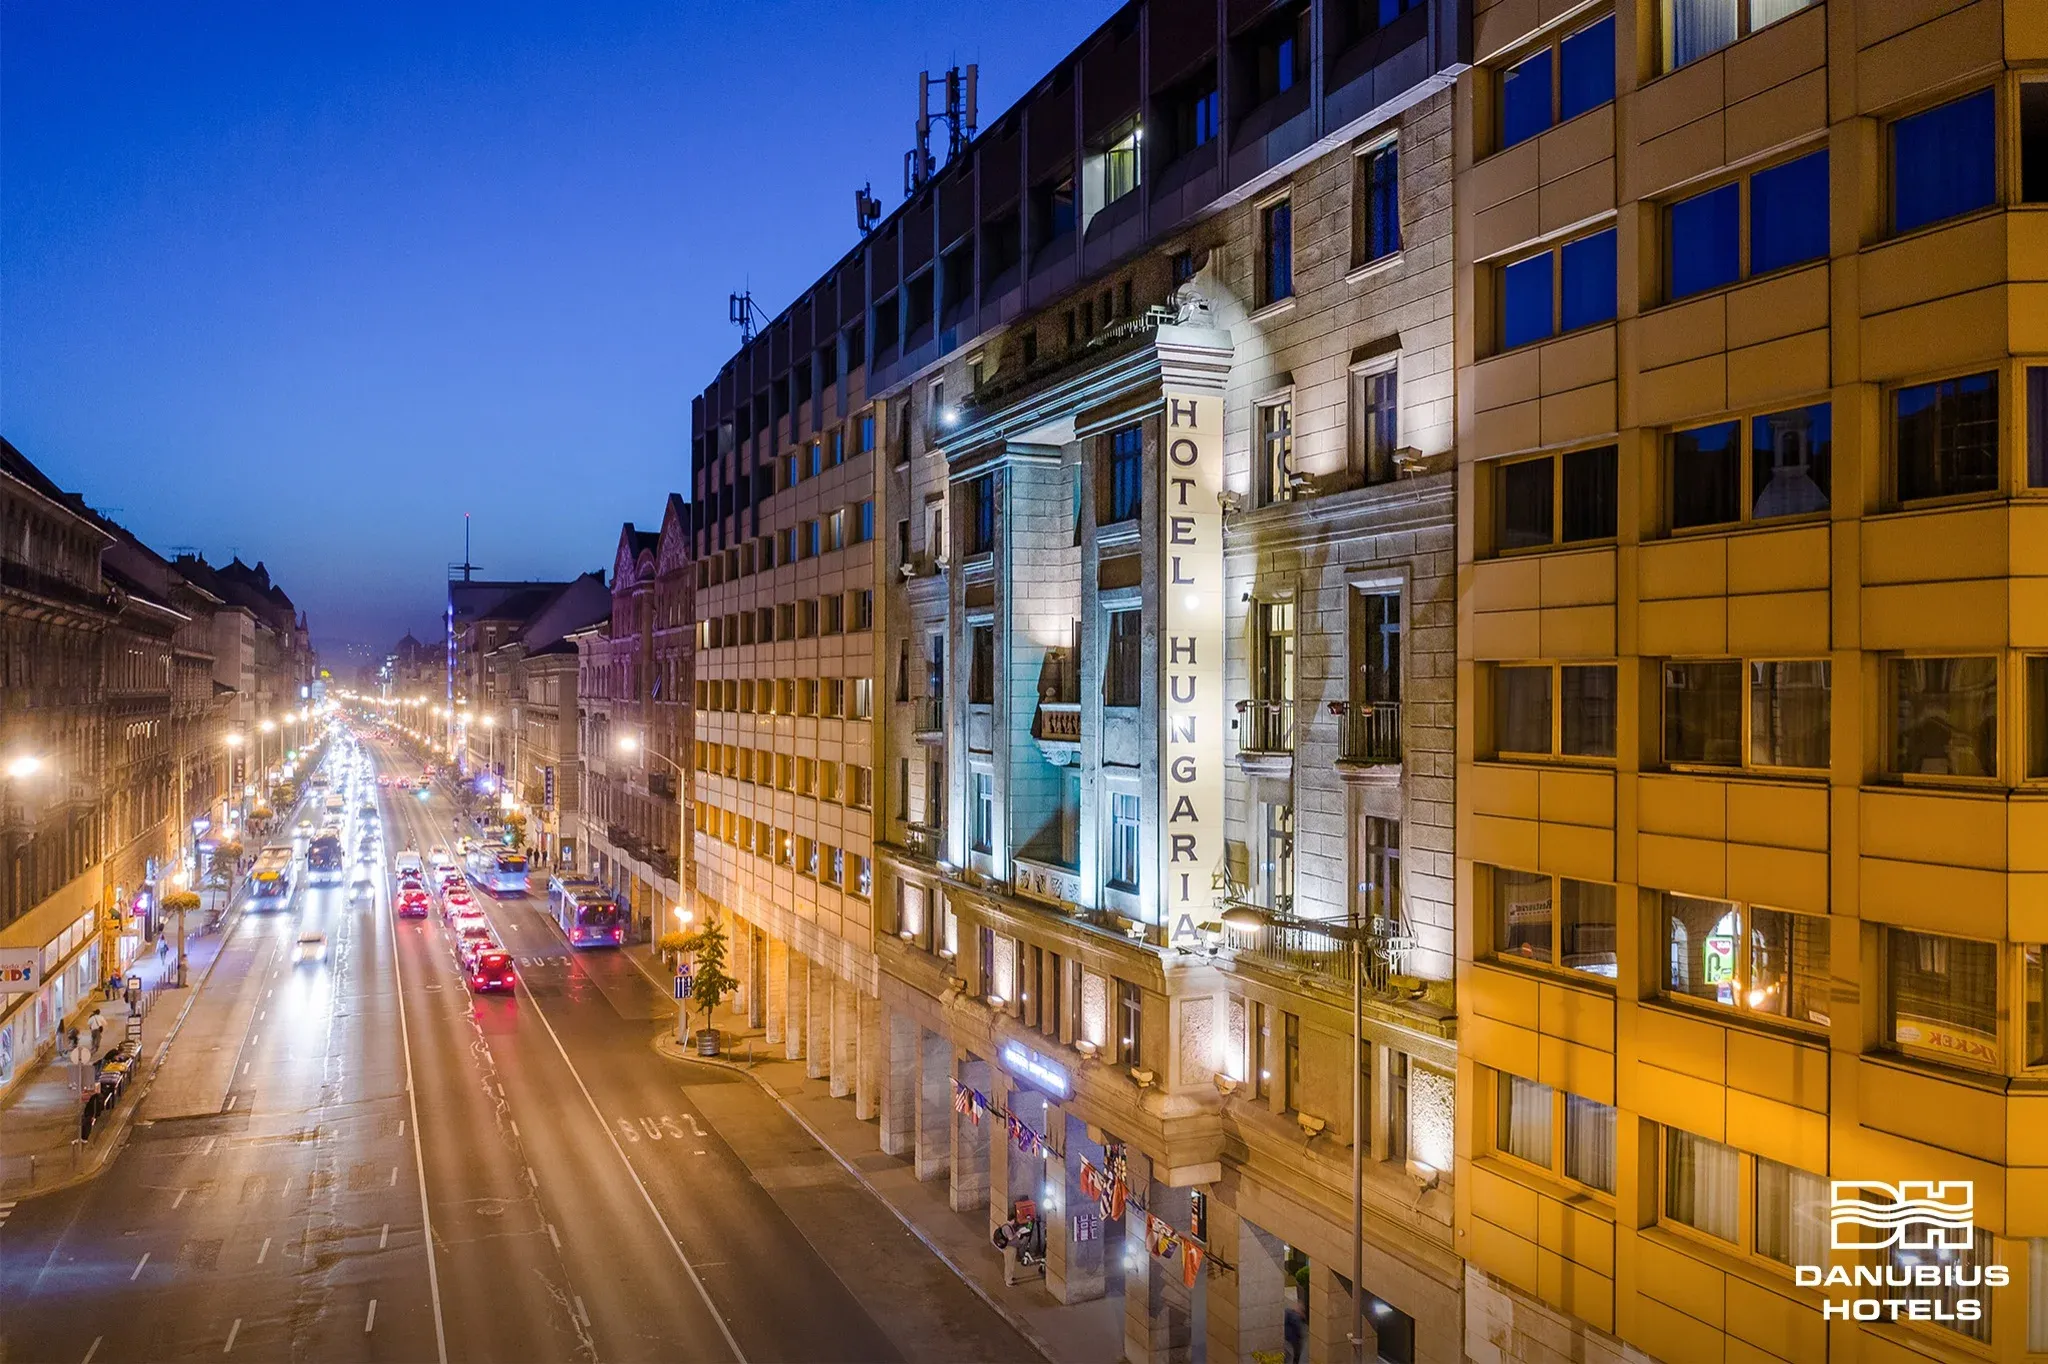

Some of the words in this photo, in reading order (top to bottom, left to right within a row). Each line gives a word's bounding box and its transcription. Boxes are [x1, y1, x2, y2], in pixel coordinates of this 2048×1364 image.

[1170, 399, 1198, 585] HOTEL
[1170, 636, 1199, 942] HUNGARIA
[616, 1113, 708, 1143] BUSZ
